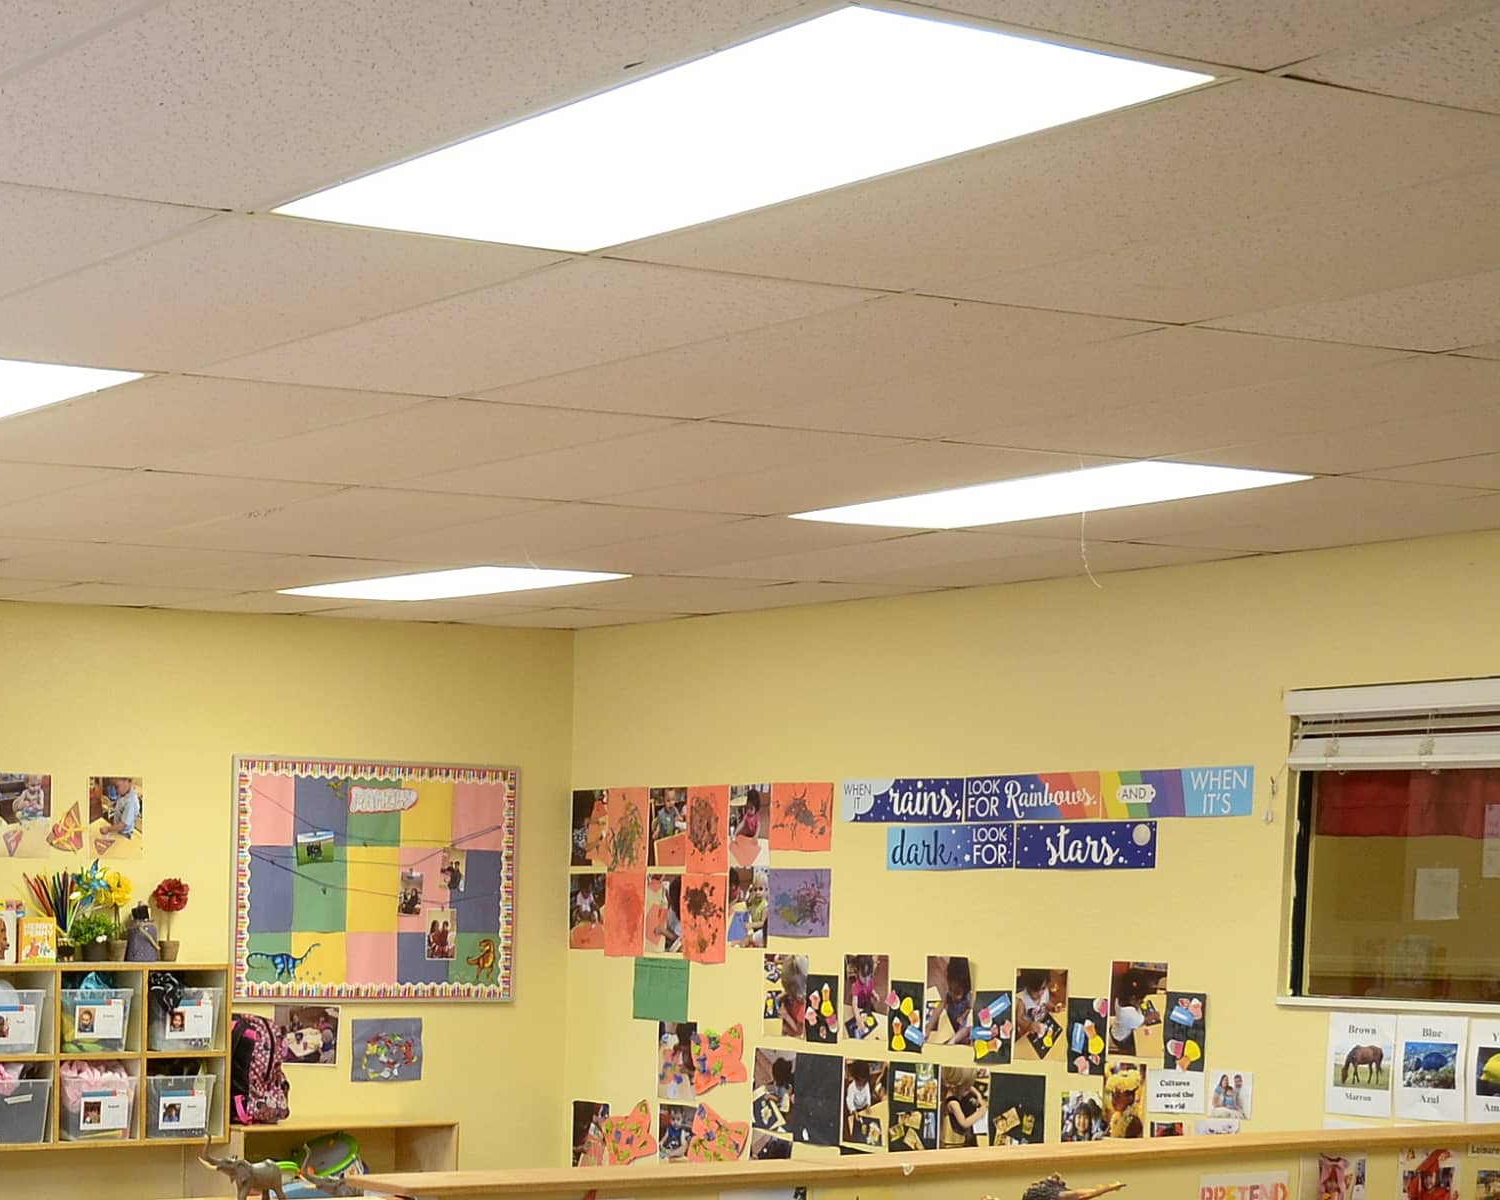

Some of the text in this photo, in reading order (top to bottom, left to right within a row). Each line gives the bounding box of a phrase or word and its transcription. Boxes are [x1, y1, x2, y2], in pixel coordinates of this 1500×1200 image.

[843, 783, 872, 796] WHEN
[968, 777, 1000, 796] LOOK
[1190, 768, 1249, 790] WHEN
[853, 797, 862, 809] IT
[888, 780, 962, 819] rains,
[1005, 780, 1098, 819] Rainbows.
[1121, 787, 1147, 800] AND
[1202, 792, 1232, 815] IT'S
[967, 797, 999, 818] FOR
[972, 826, 1007, 842] LOOK
[891, 829, 958, 867] dark,
[972, 844, 1007, 865] FOR
[1046, 825, 1125, 866] stars.
[1348, 1025, 1377, 1035] Brown
[1419, 1095, 1440, 1105] Azul
